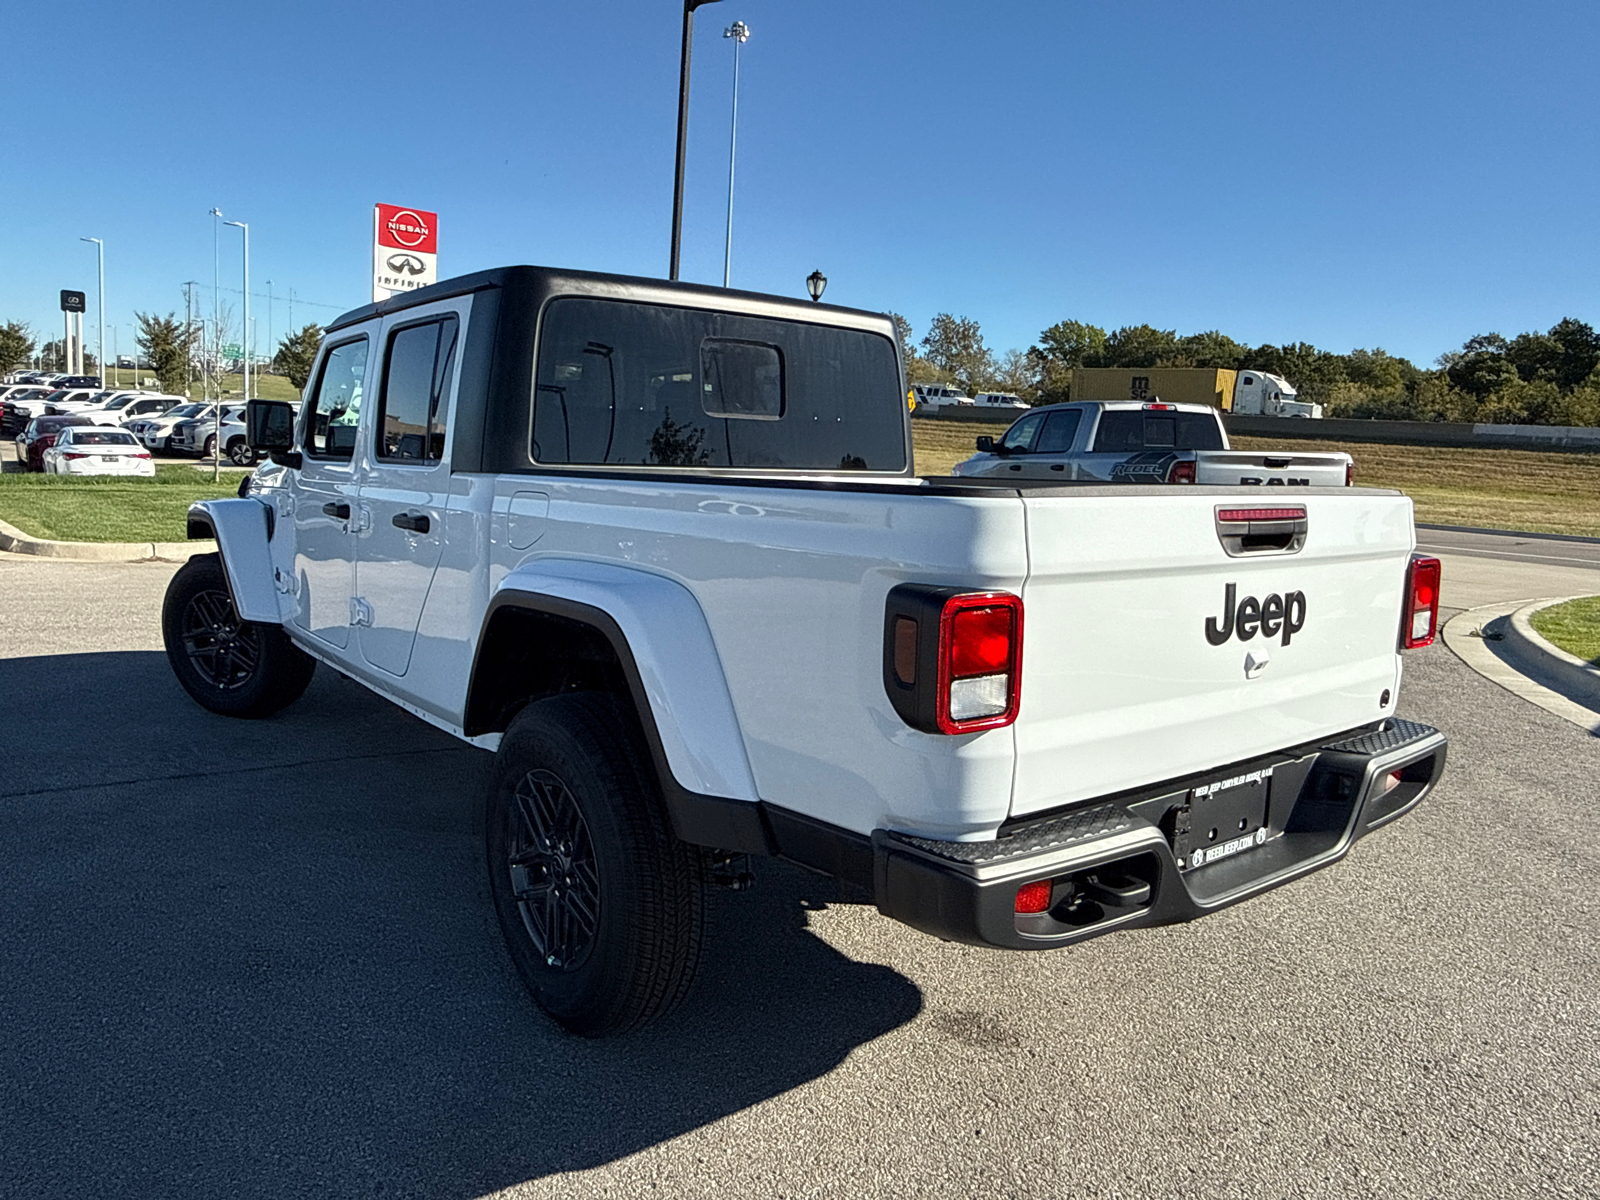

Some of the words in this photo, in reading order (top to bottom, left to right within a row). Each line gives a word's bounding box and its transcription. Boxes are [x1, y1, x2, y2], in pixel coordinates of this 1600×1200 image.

[387, 222, 429, 235] NISSAN
[378, 276, 428, 289] INFINIT
[1110, 464, 1163, 475] REBEL
[1240, 477, 1309, 486] RAM
[1205, 582, 1306, 647] Jeep
[1209, 782, 1221, 793] JEEP
[1206, 835, 1254, 862] REEDJEEP.COM
